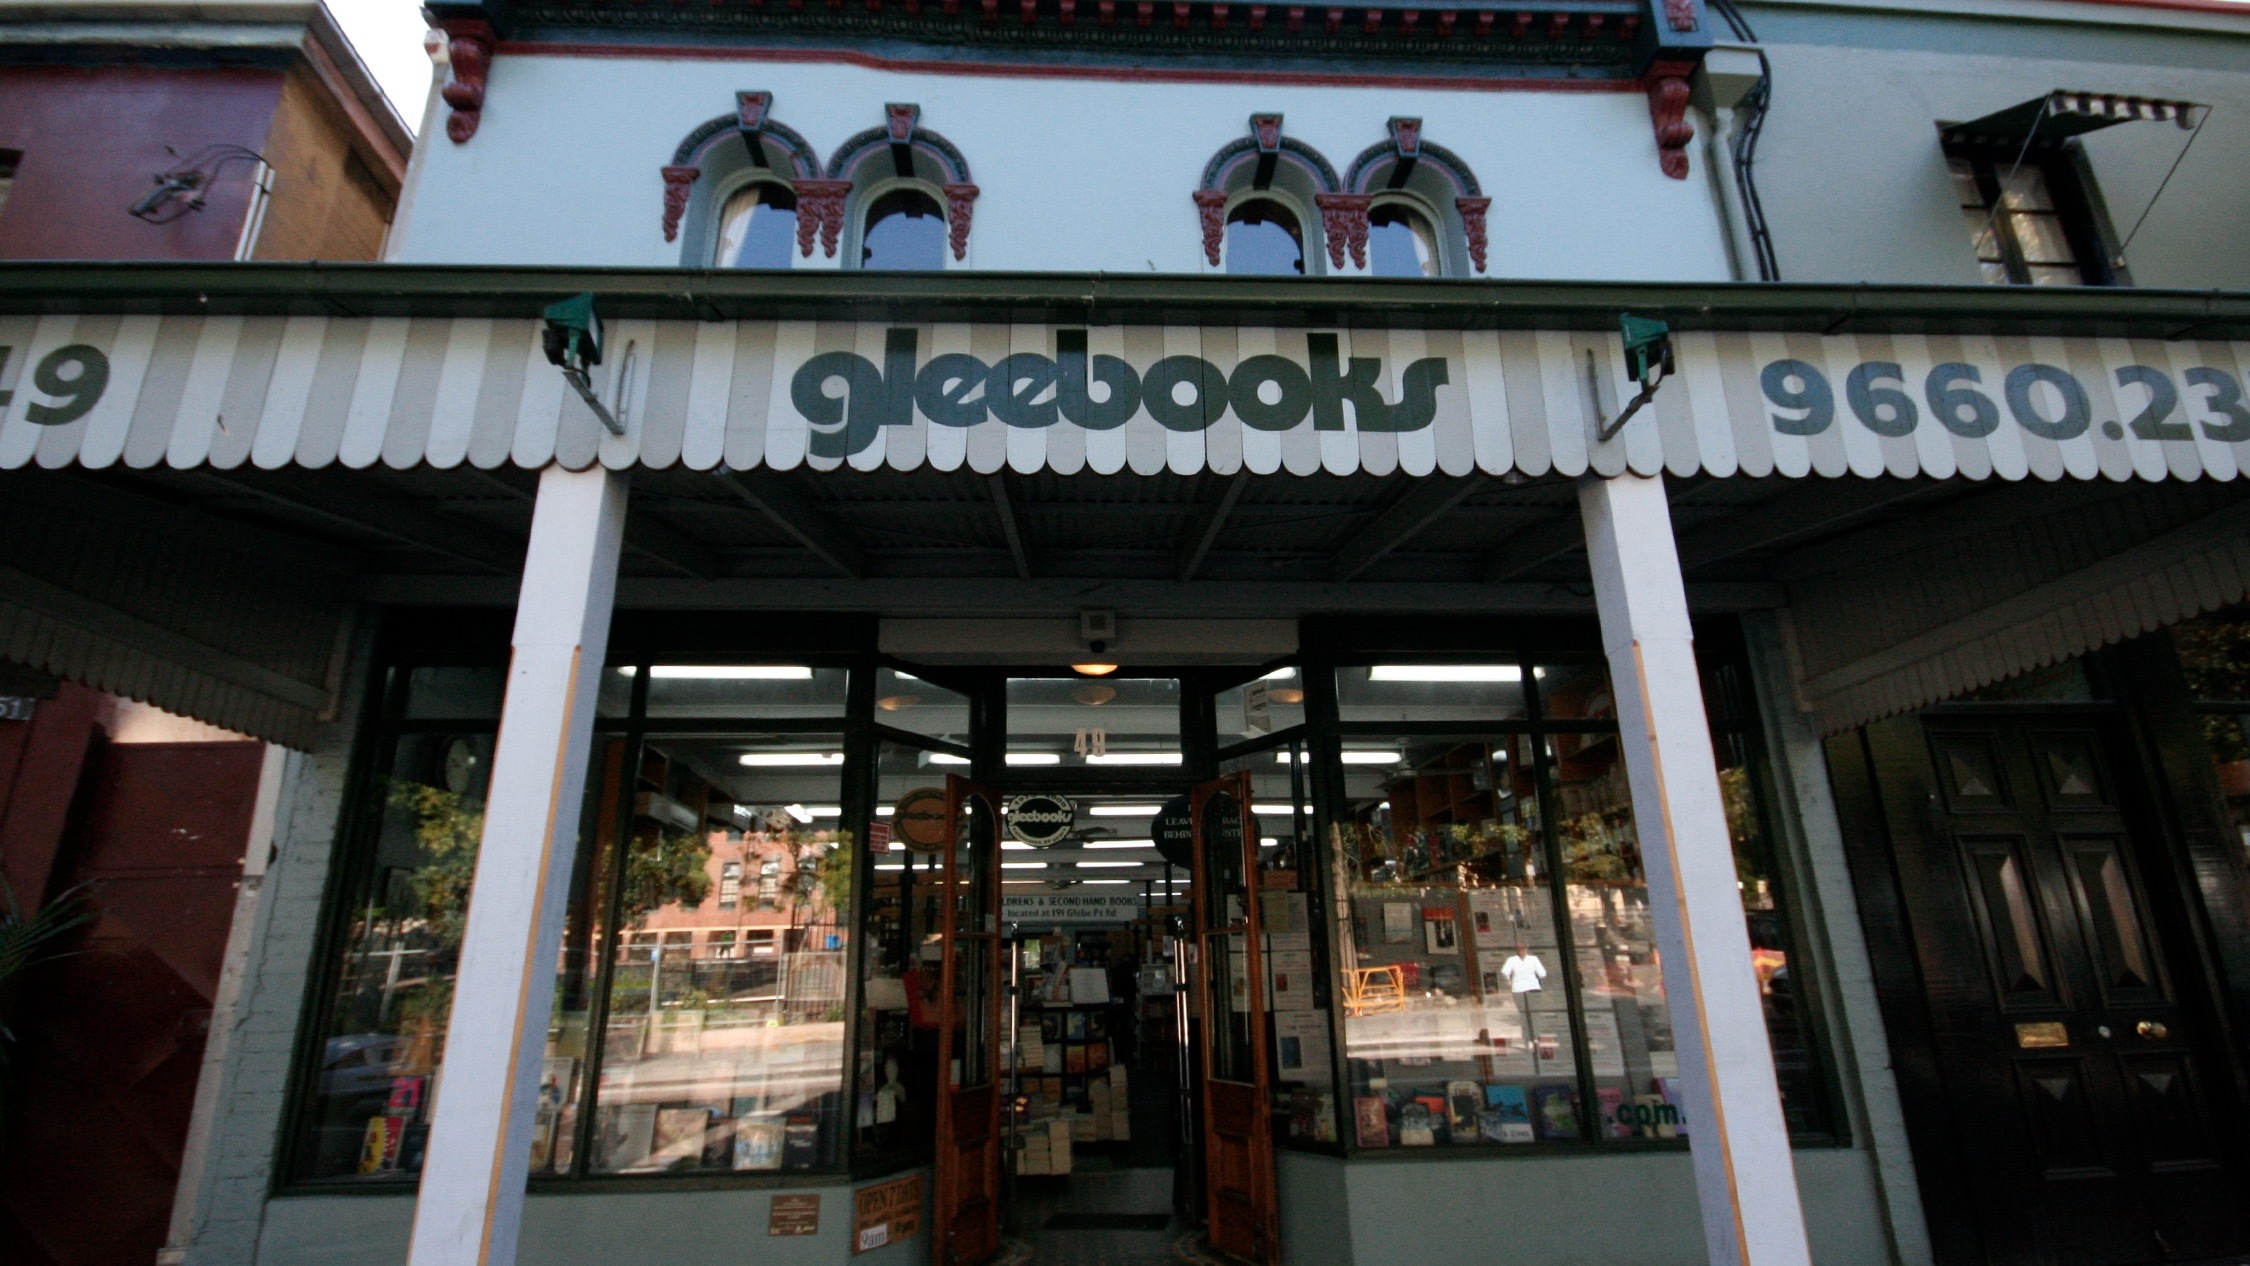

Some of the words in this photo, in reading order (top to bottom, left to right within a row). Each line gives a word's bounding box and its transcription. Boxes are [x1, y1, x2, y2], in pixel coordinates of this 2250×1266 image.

[791, 328, 1449, 458] gleebooks
[1073, 727, 1106, 759] 49
[1008, 809, 1072, 826] gleebooks
[1165, 817, 1192, 826] LEAV
[1164, 830, 1192, 839] BEHIN
[1038, 897, 1045, 906] &
[1048, 896, 1081, 906] SECOND
[1082, 896, 1107, 906] HAND
[1109, 896, 1138, 906] BOOKS
[1041, 909, 1050, 917] at
[1066, 908, 1091, 917] Glebe
[1093, 908, 1103, 917] Pt
[1105, 908, 1117, 917] Rd
